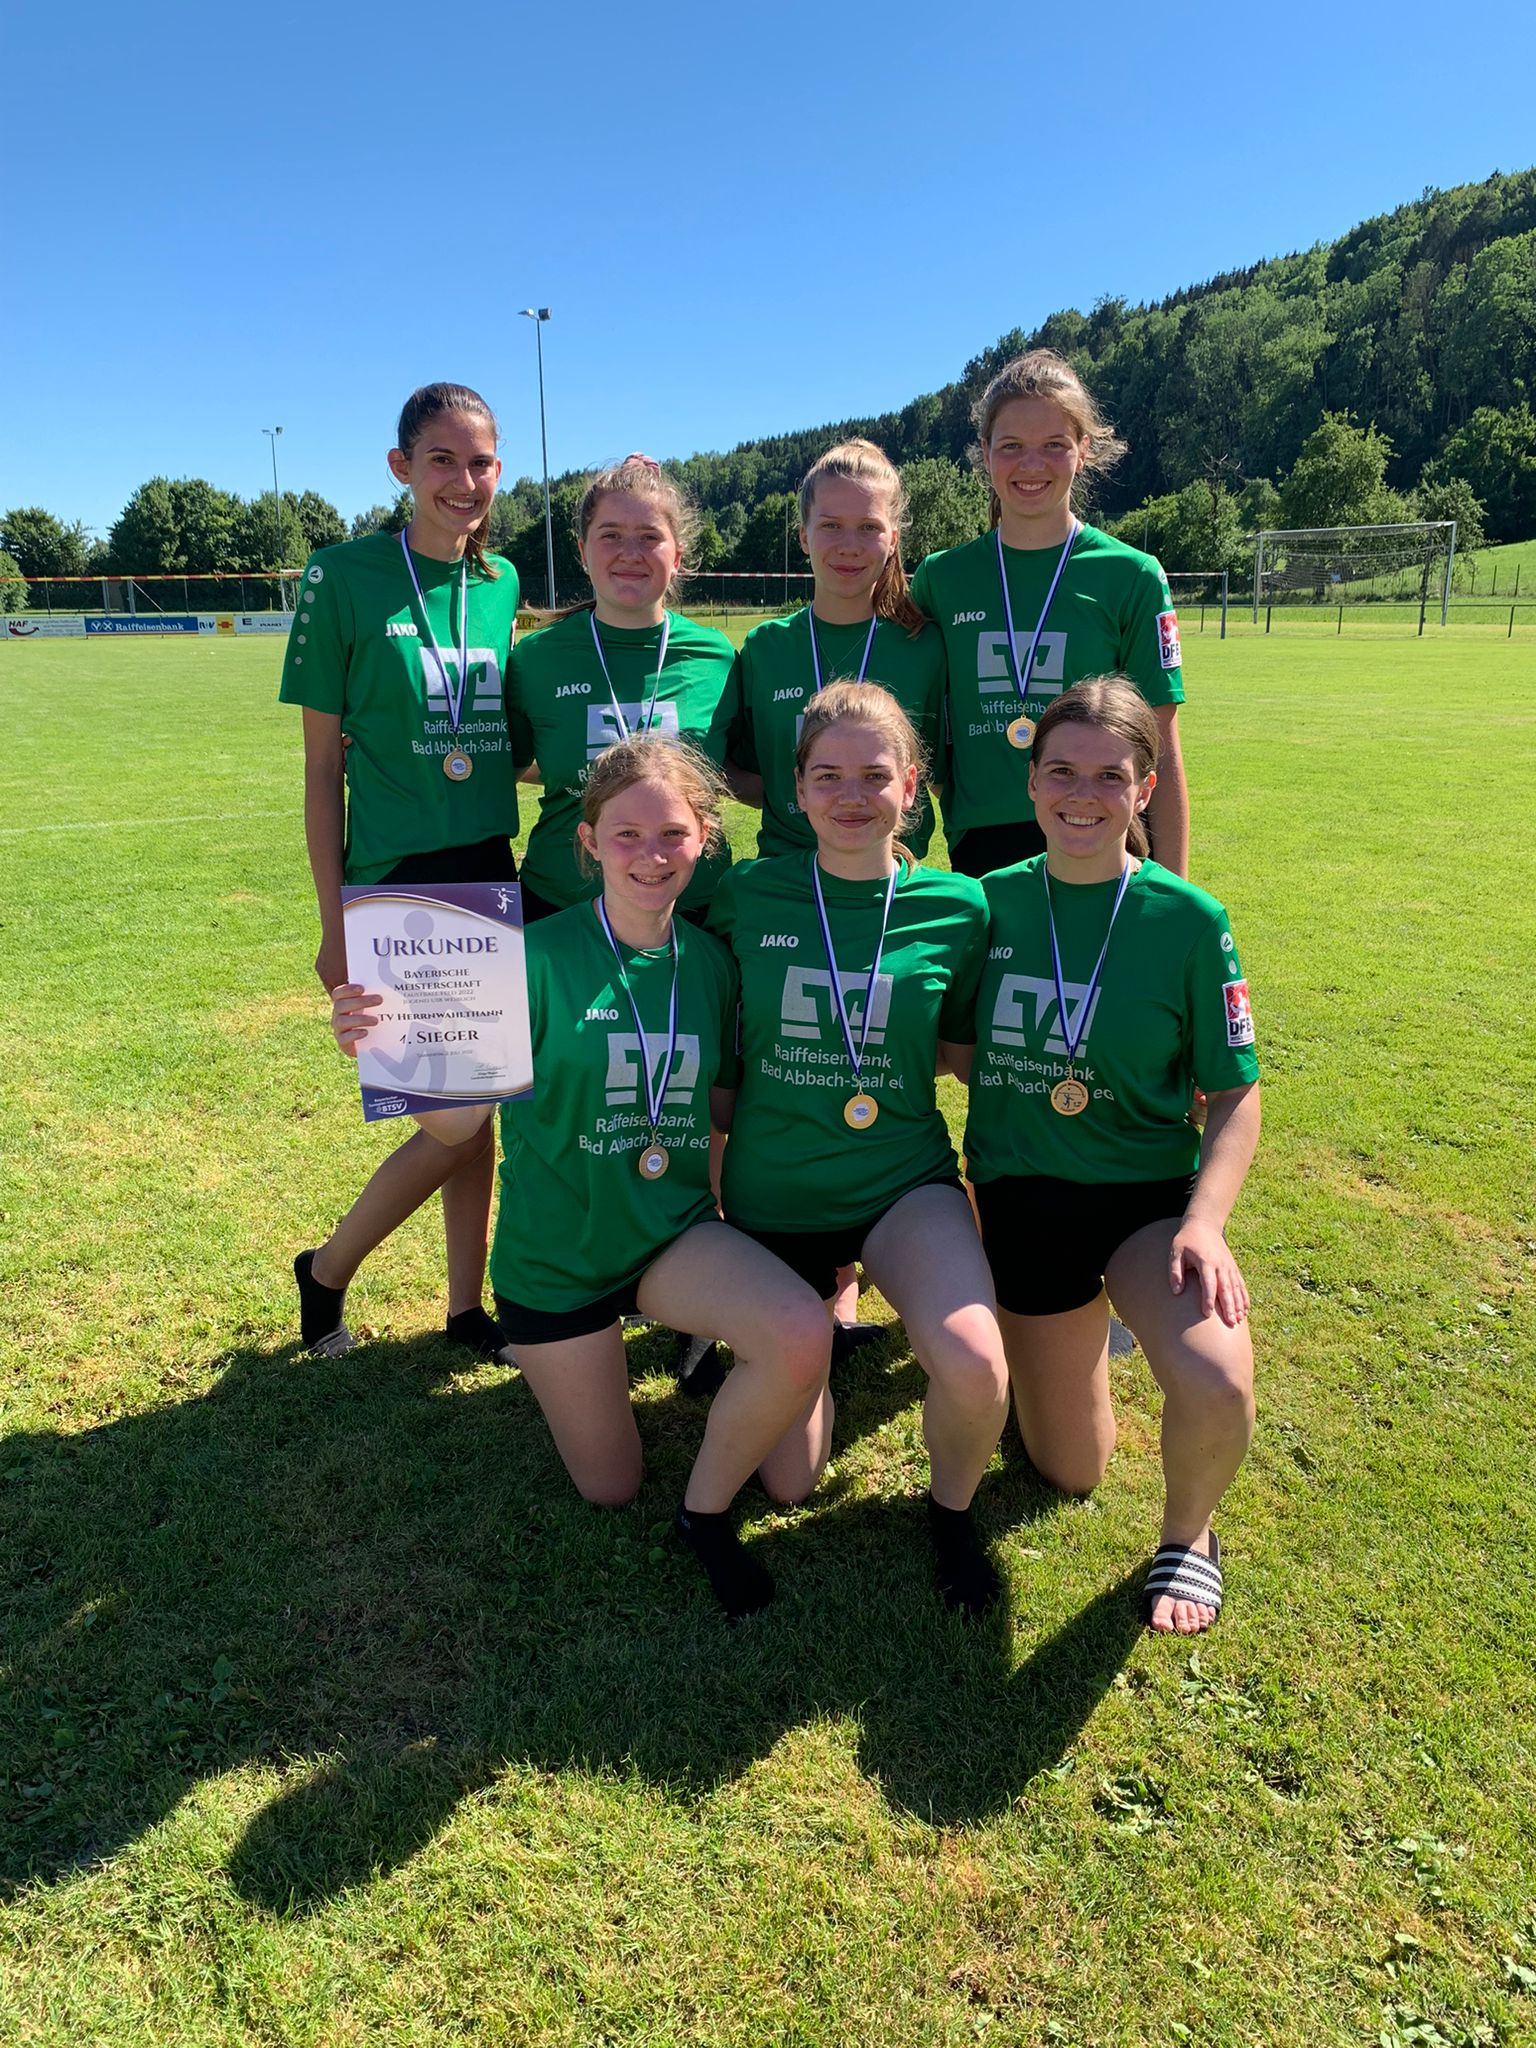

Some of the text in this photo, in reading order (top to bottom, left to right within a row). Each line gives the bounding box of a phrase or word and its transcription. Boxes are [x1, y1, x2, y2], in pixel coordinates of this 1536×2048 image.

[8, 620, 29, 628] HAF
[952, 610, 987, 626] JAKO
[115, 622, 185, 632] Raiffeisenbank
[385, 623, 419, 637] JAKO
[555, 683, 592, 698] JAKO
[772, 686, 804, 702] JAKO
[968, 720, 992, 737] Bad
[411, 740, 433, 755] Bad
[786, 801, 805, 815] Ba
[372, 936, 500, 957] URKUNDE
[760, 934, 800, 948] JAKO
[988, 946, 1014, 960] AKO
[403, 968, 471, 980] BAYERISCHE
[393, 979, 483, 992] MEISTERSCHAFT
[377, 1012, 394, 1022] TV
[584, 1008, 620, 1021] JAKO
[416, 1030, 480, 1044] SIEGER
[774, 1043, 893, 1069] Raiffeisenank
[760, 1058, 782, 1080] Bad
[382, 1102, 403, 1112] BTSV
[688, 1135, 711, 1149] eG
